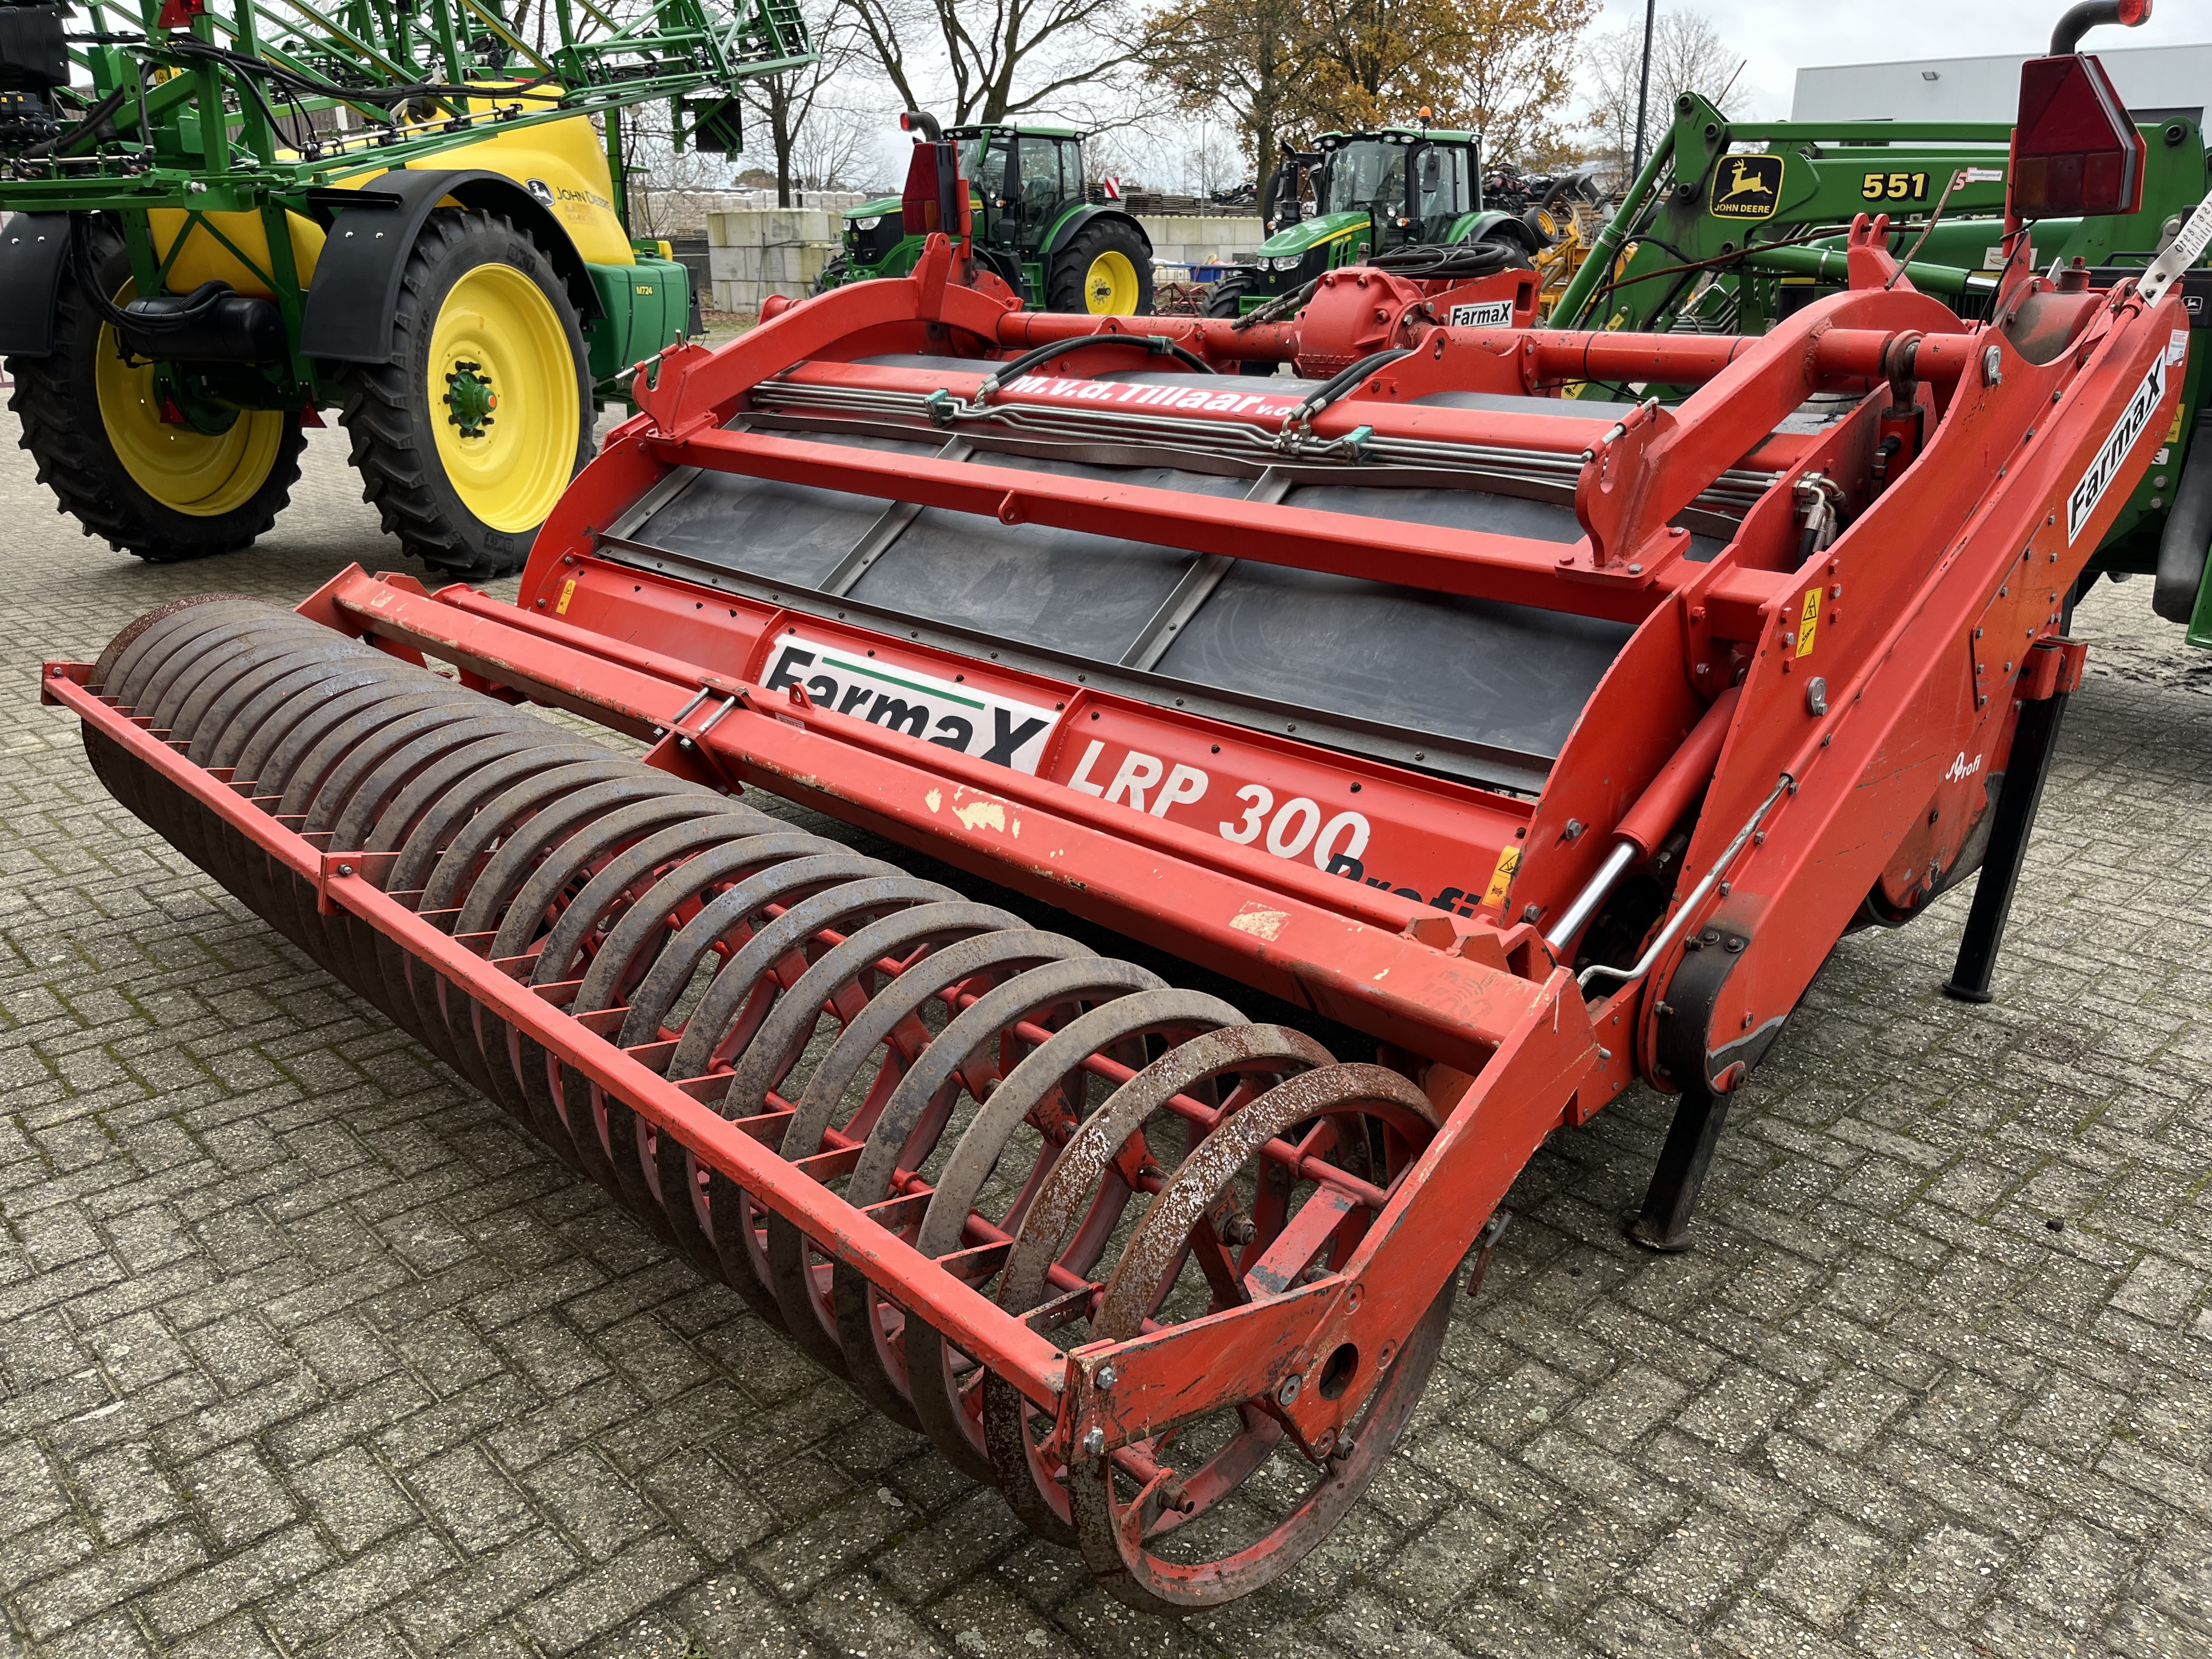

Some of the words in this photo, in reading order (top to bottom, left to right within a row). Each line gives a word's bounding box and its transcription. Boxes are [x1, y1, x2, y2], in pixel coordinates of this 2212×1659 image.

[556, 187, 586, 203] JOHN
[1862, 173, 1927, 200] 551
[1714, 204, 1739, 212] JOHN
[1740, 205, 1771, 213] DEERE
[636, 285, 653, 295] M724
[1451, 302, 1512, 327] FarmaX
[1003, 375, 1114, 400] M.v.d.
[1116, 383, 1267, 413] Tillaar
[2070, 353, 2163, 534] FarmaX
[765, 646, 1050, 769] FarmaX
[1067, 740, 1209, 818] LRP
[1219, 784, 1370, 874] 300
